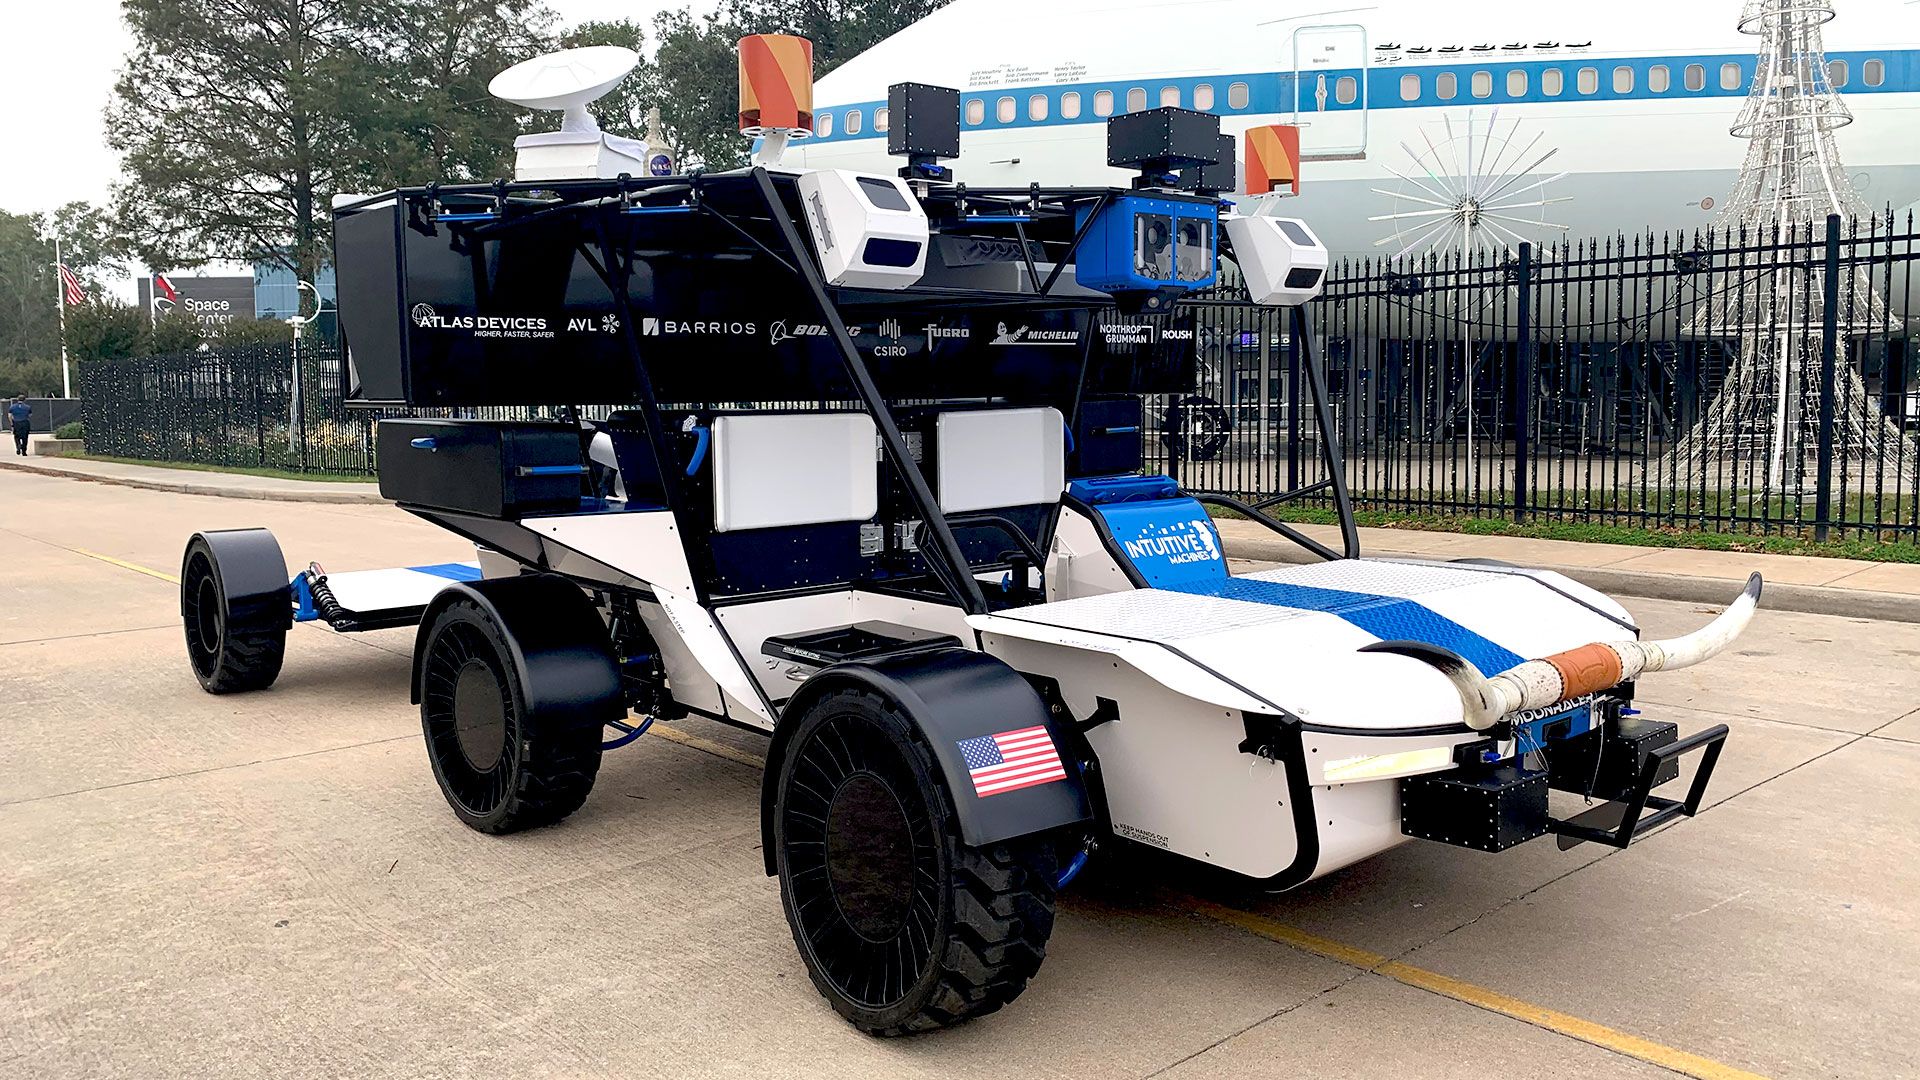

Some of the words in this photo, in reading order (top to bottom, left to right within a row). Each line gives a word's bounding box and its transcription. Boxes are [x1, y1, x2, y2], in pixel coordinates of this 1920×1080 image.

[184, 298, 230, 313] Space
[186, 312, 234, 325] enter
[419, 316, 474, 328] ATLAS
[477, 317, 547, 329] DEVICES
[567, 318, 597, 331] AVL
[474, 330, 502, 338] HIGHER,
[664, 321, 756, 334] BARRIOS
[793, 324, 861, 337] BOEG
[1100, 324, 1141, 334] NORTHROP
[1027, 330, 1079, 340] MICHELIN
[1105, 334, 1147, 343] GRUMMAN
[1162, 329, 1192, 340] ROUSH
[874, 346, 907, 356] CSIRO
[1124, 533, 1202, 559] INTUITIVE
[1168, 550, 1210, 565] MACHINES
